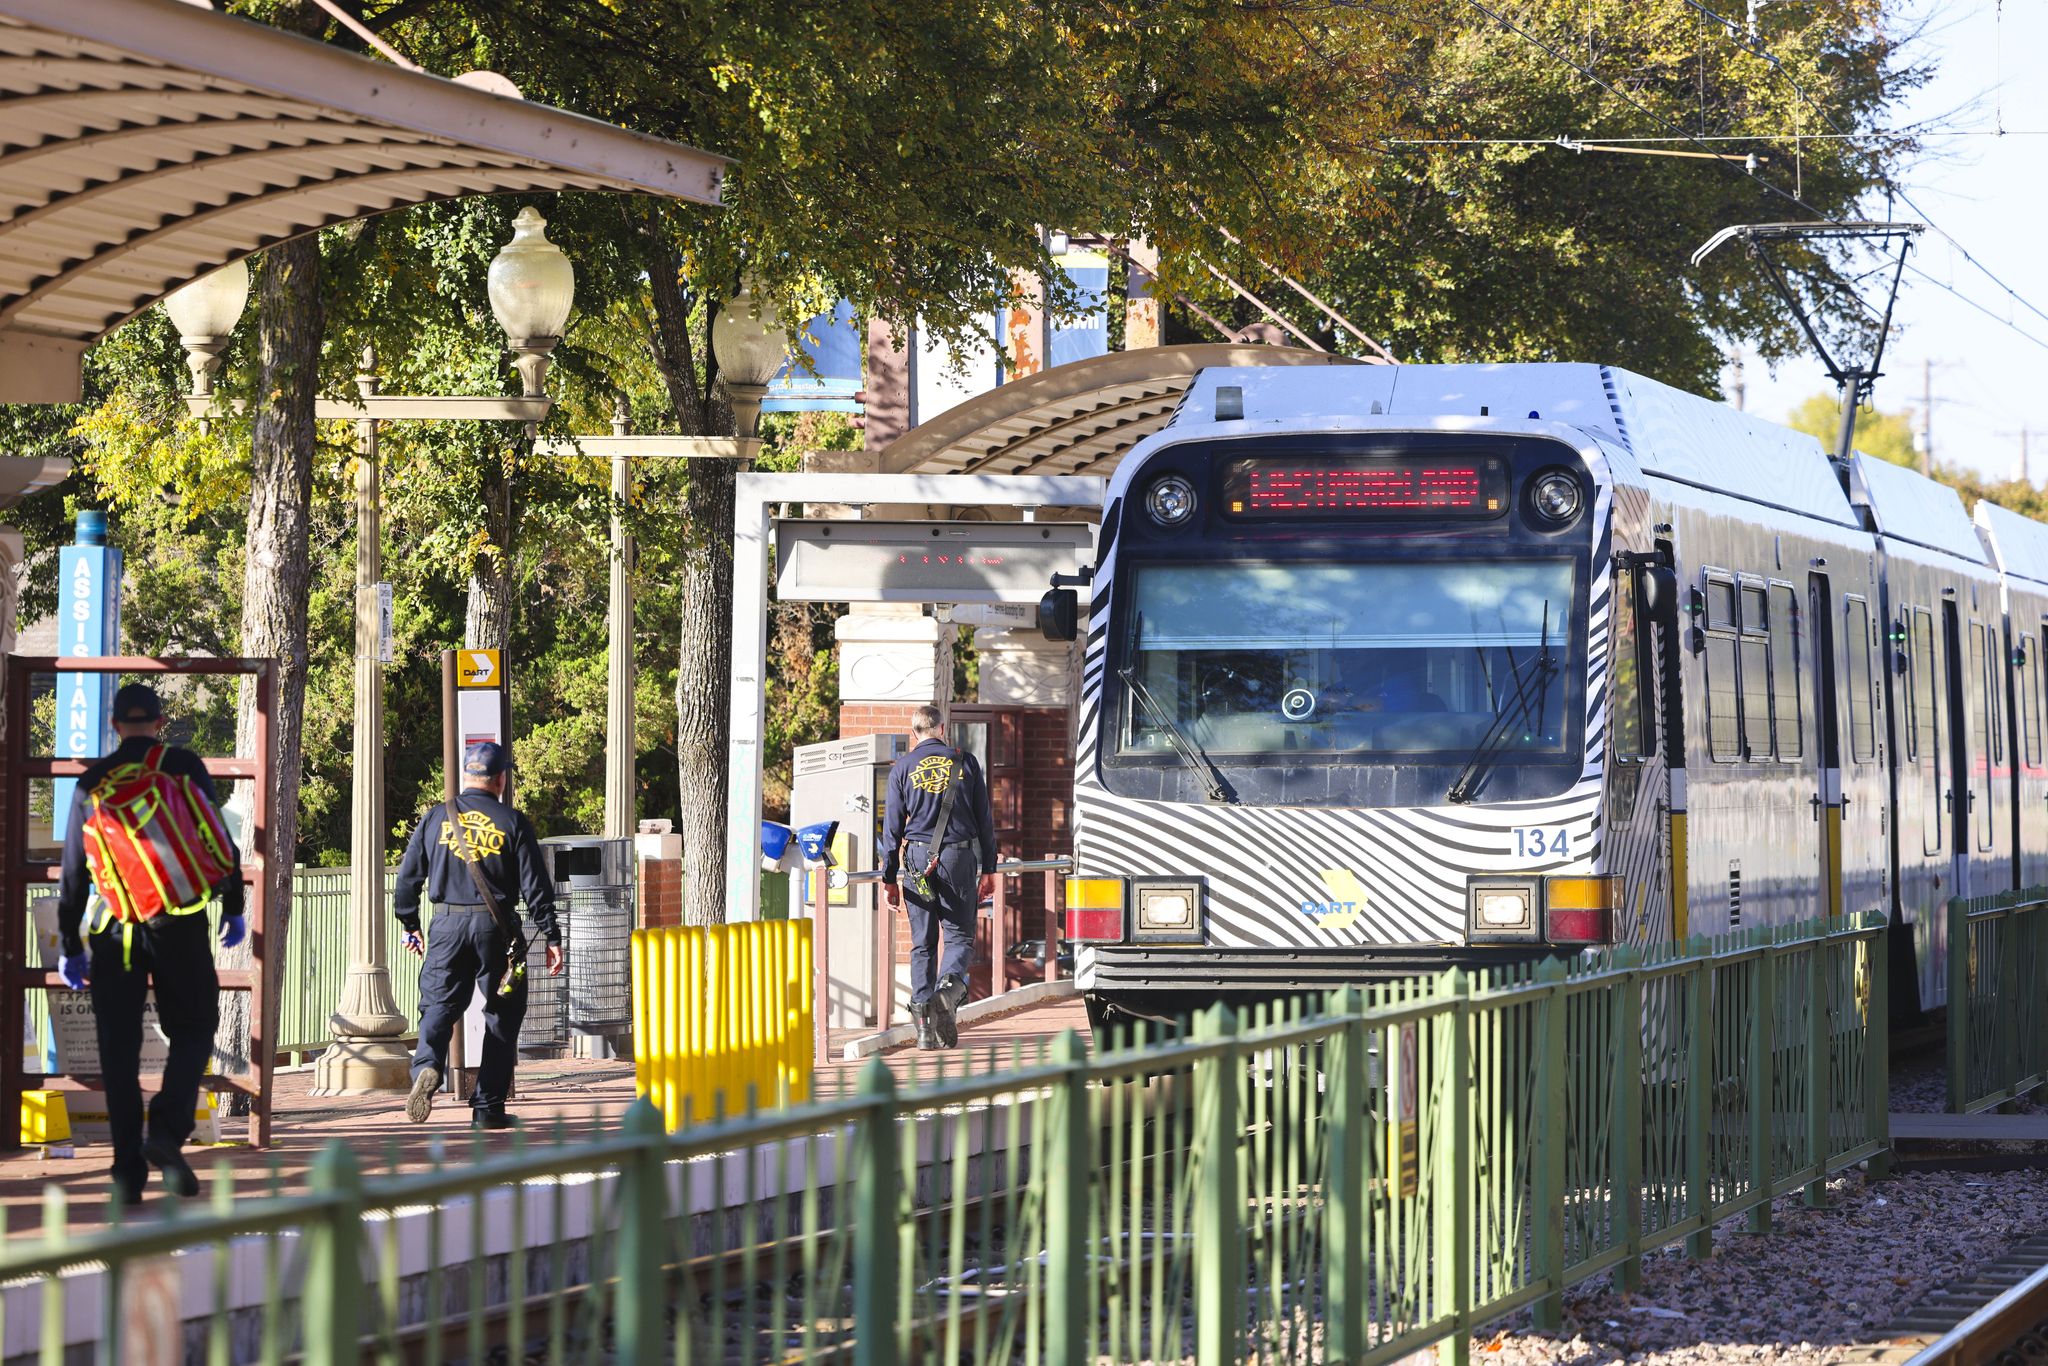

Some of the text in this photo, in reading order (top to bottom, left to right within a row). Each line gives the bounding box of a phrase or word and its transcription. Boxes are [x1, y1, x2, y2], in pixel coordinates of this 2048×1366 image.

[69, 557, 91, 758] ASSISANC
[910, 766, 963, 786] PLAN
[1514, 829, 1569, 857] 134
[1301, 902, 1356, 914] DART
